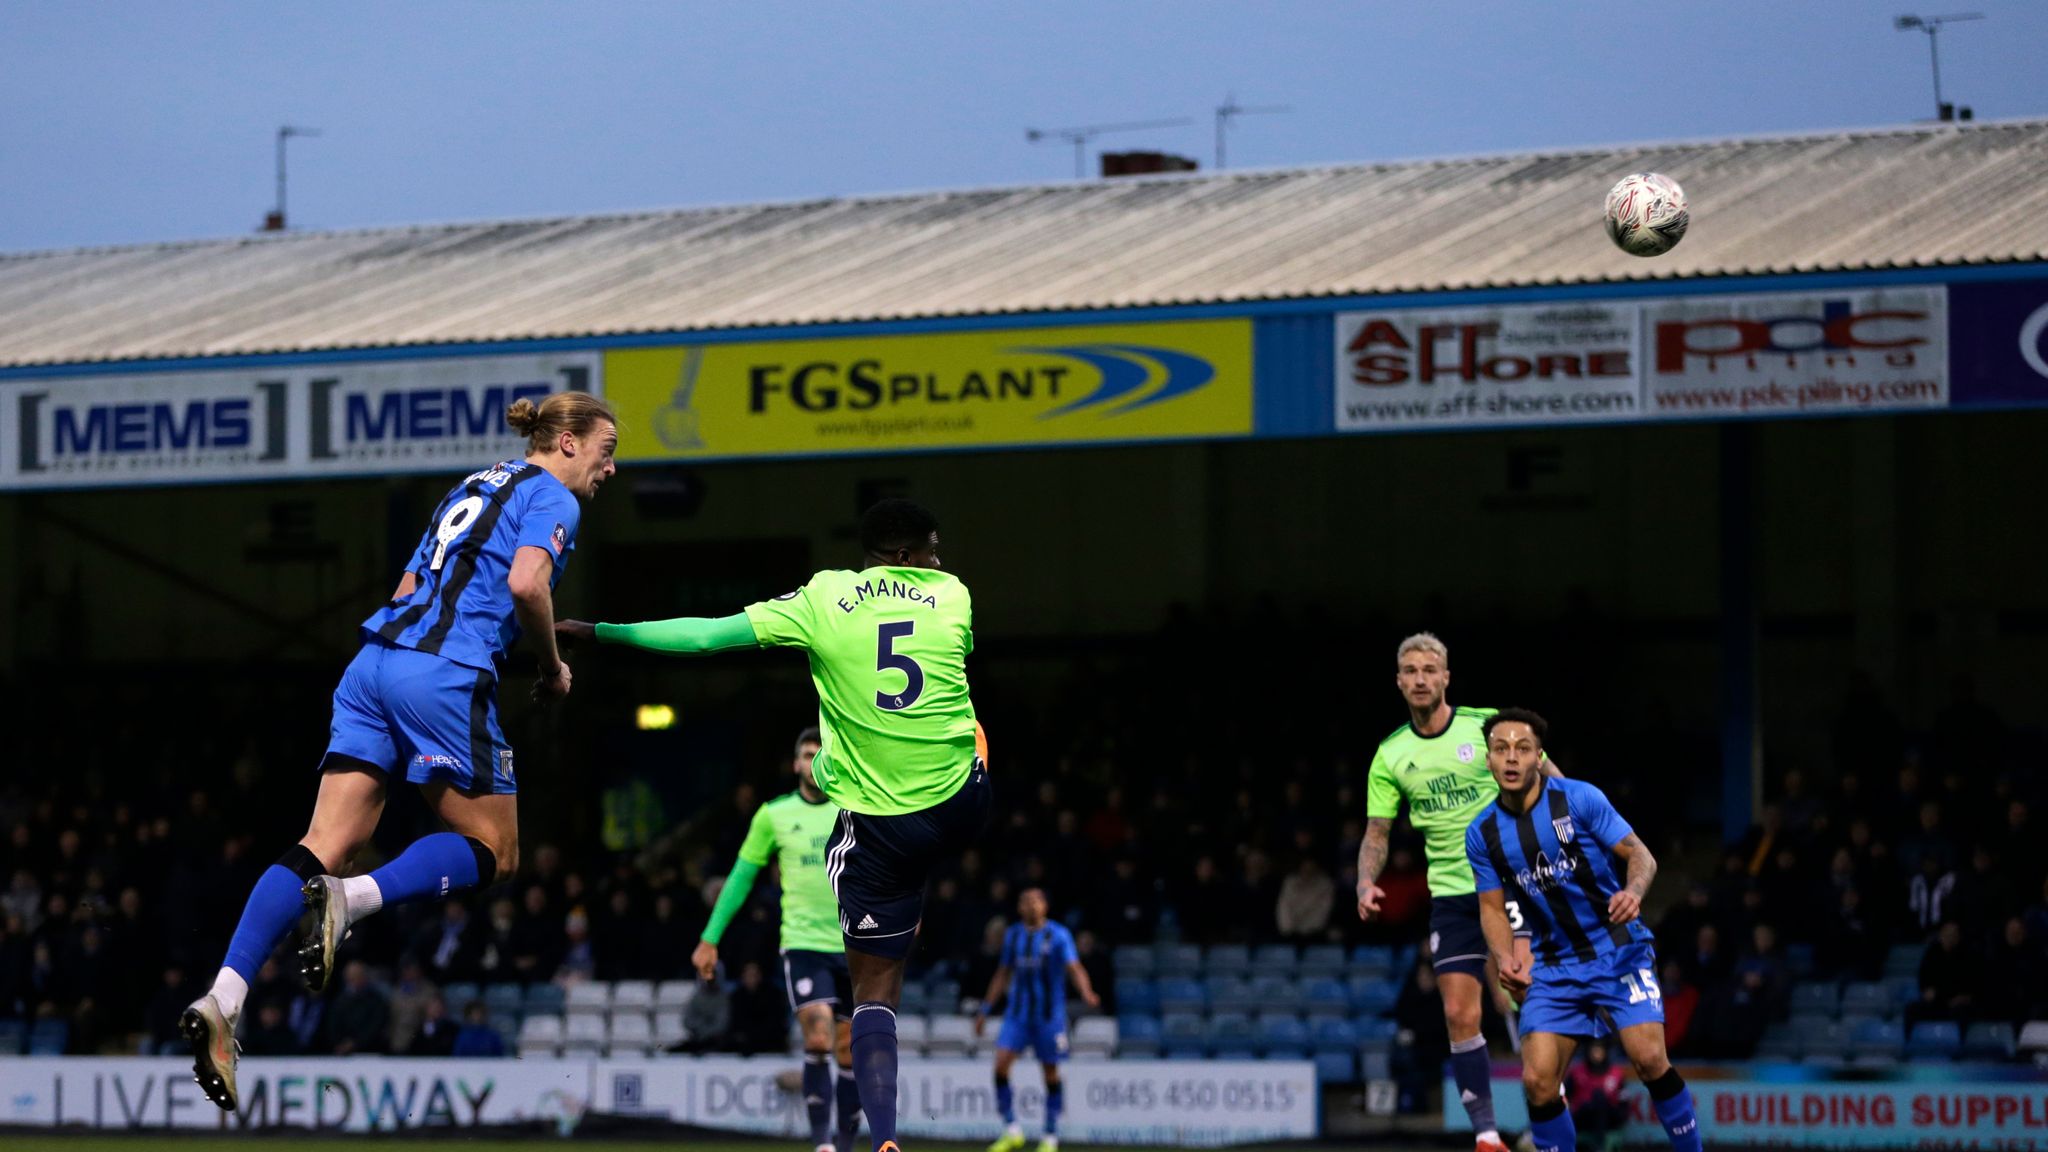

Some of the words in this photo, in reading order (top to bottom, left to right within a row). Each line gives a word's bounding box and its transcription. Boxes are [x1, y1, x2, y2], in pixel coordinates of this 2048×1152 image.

[53, 398, 252, 455] MEMS
[429, 495, 484, 570] 9
[837, 578, 937, 614] E.MANGA
[875, 620, 924, 711] 5
[1419, 785, 1480, 813] MALAYSIA
[1426, 772, 1457, 795] VISIT
[1505, 900, 1524, 930] 3
[1620, 967, 1662, 1005] 15
[221, 1075, 495, 1128] MEDWAY
[1713, 1093, 1897, 1127] BUILDING
[1910, 1094, 2048, 1129] SUPPL
